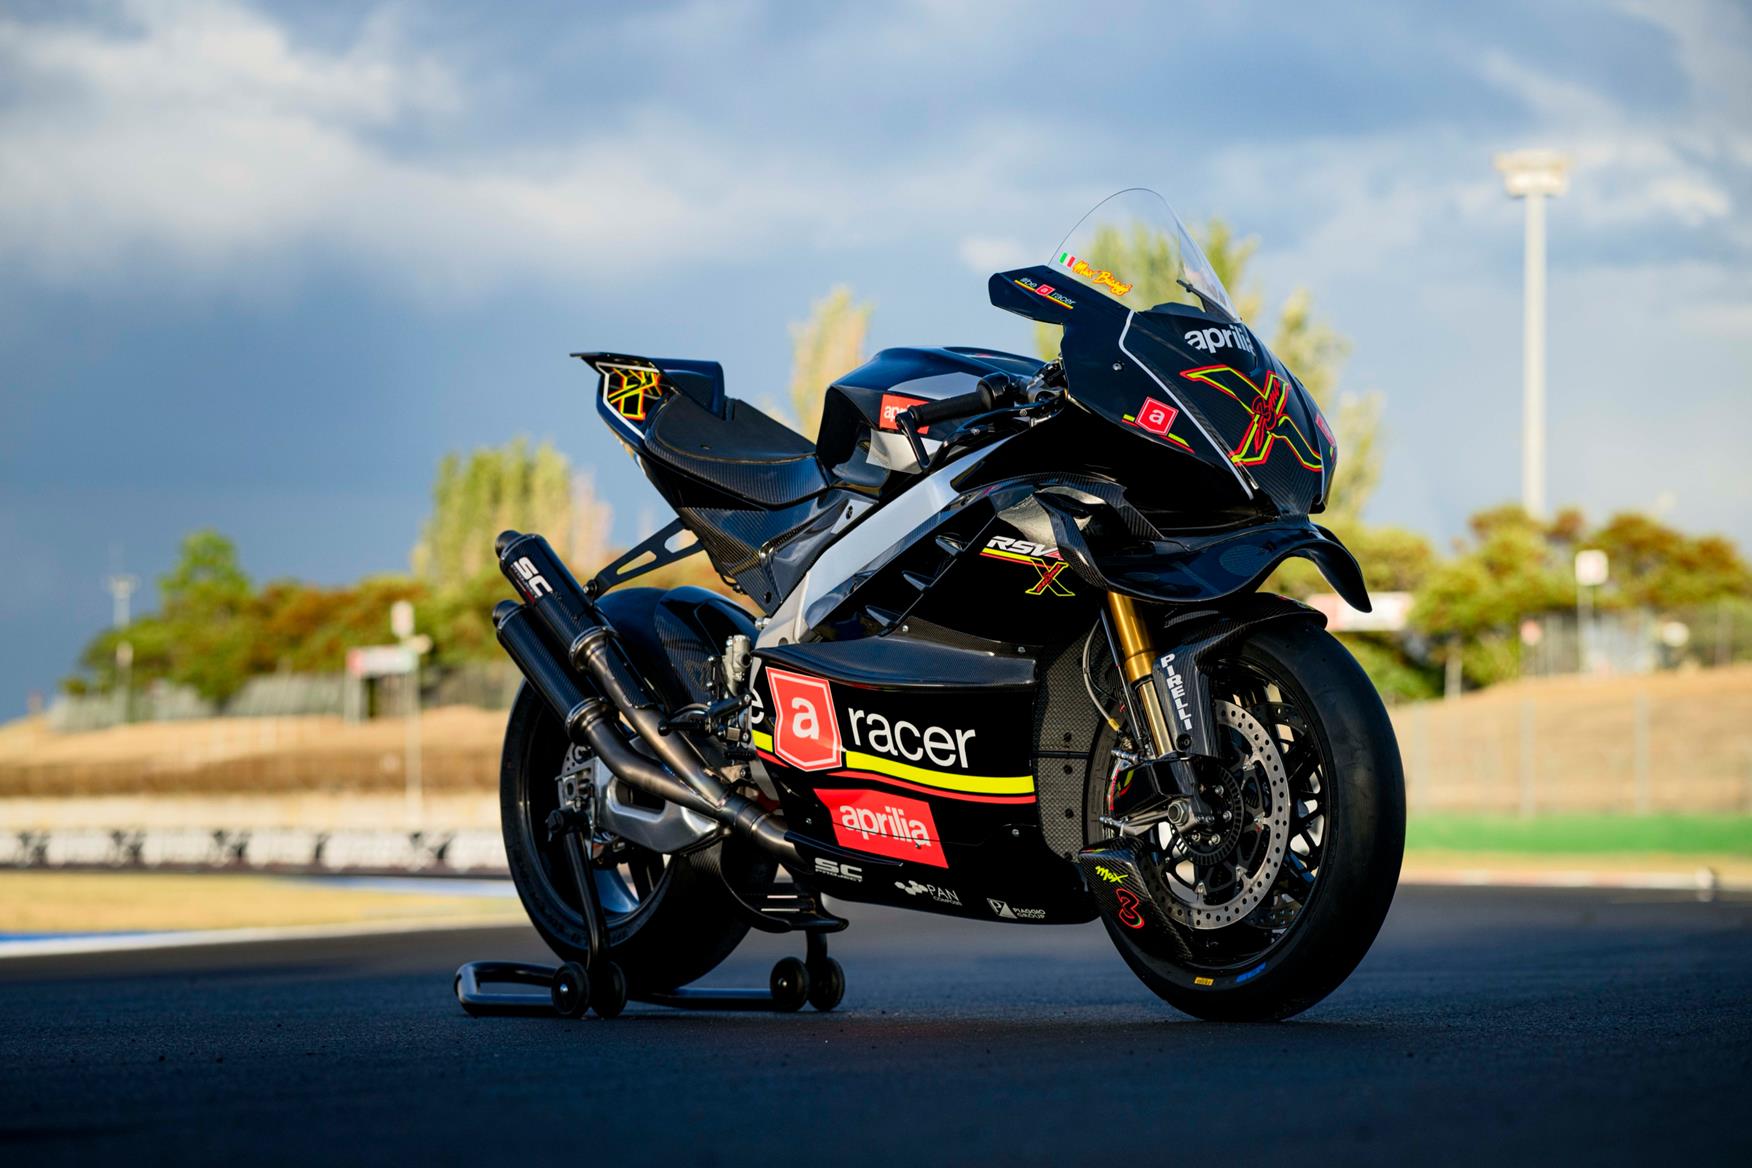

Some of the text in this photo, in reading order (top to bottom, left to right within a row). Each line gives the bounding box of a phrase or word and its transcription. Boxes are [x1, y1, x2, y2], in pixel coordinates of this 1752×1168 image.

[1051, 292, 1077, 305] racer
[1148, 408, 1166, 426] a
[512, 556, 554, 598] SC
[1160, 653, 1193, 731] PIRELLI
[791, 696, 820, 740] a
[847, 707, 977, 769] racer
[839, 805, 932, 848] aprilia
[814, 857, 863, 879] SC
[926, 884, 960, 901] PAN
